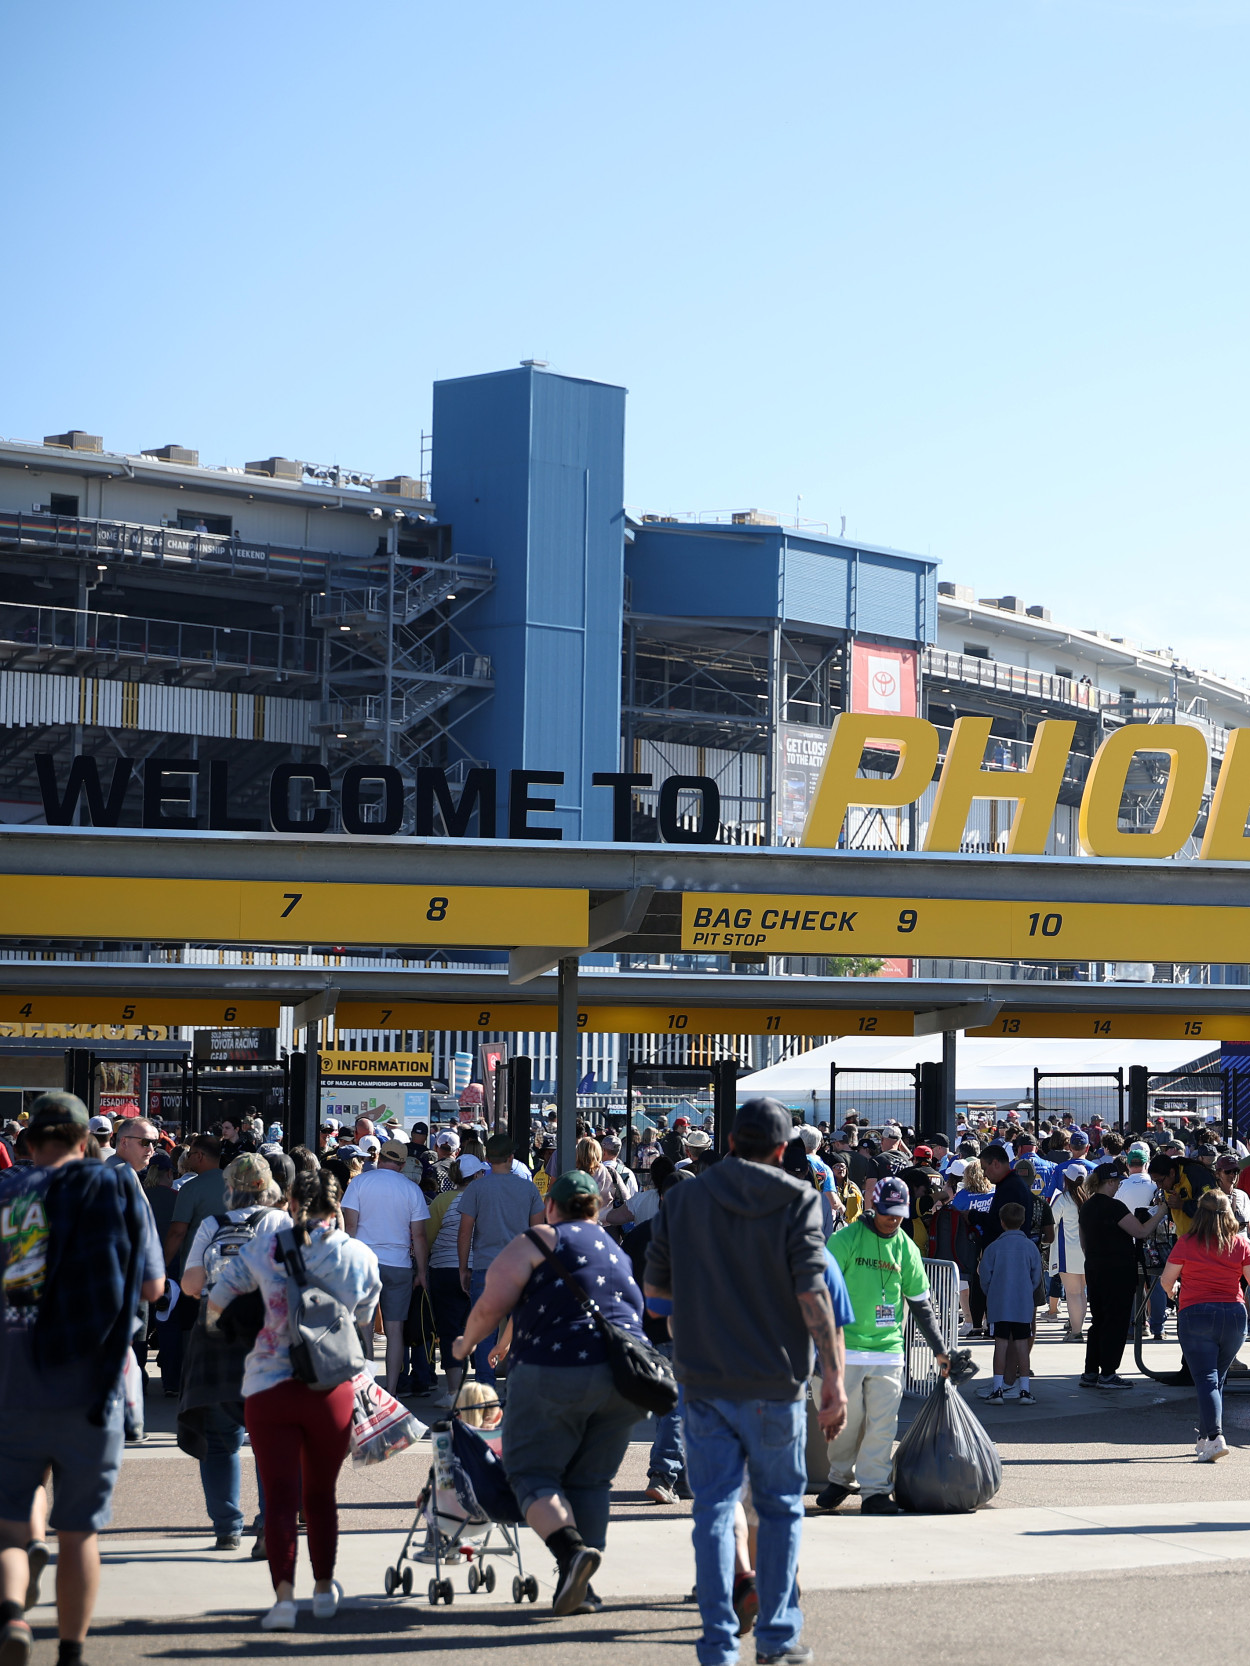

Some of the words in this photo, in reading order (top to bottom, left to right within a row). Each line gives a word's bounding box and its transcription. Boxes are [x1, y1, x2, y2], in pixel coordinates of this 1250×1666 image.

[786, 738, 802, 753] GET
[787, 752, 796, 764] TO
[797, 754, 809, 765] THE
[34, 754, 564, 841] WELCOME
[592, 773, 720, 843] TO
[281, 893, 302, 917] 7
[426, 897, 449, 921] 8
[693, 907, 752, 929] BAG
[760, 909, 858, 932] CHECK
[896, 909, 918, 933] 9
[1029, 912, 1063, 937] 10
[693, 932, 720, 945] PIT
[722, 933, 767, 947] STOP
[18, 1003, 33, 1018] 4
[121, 1004, 137, 1020] 5
[223, 1006, 238, 1022] 6
[380, 1010, 393, 1025] 7
[477, 1011, 491, 1026] 8
[576, 1013, 589, 1027] 9
[668, 1014, 689, 1029] 10
[766, 1015, 782, 1031] 11
[858, 1016, 878, 1032] 12
[1001, 1018, 1021, 1033] 13
[1093, 1019, 1112, 1035] 14
[1184, 1021, 1203, 1036] 15
[211, 1039, 234, 1050] TOYOTA
[235, 1038, 259, 1049] RACING
[337, 1059, 429, 1073] INFORMATION
[100, 1098, 139, 1107] UESADILAS
